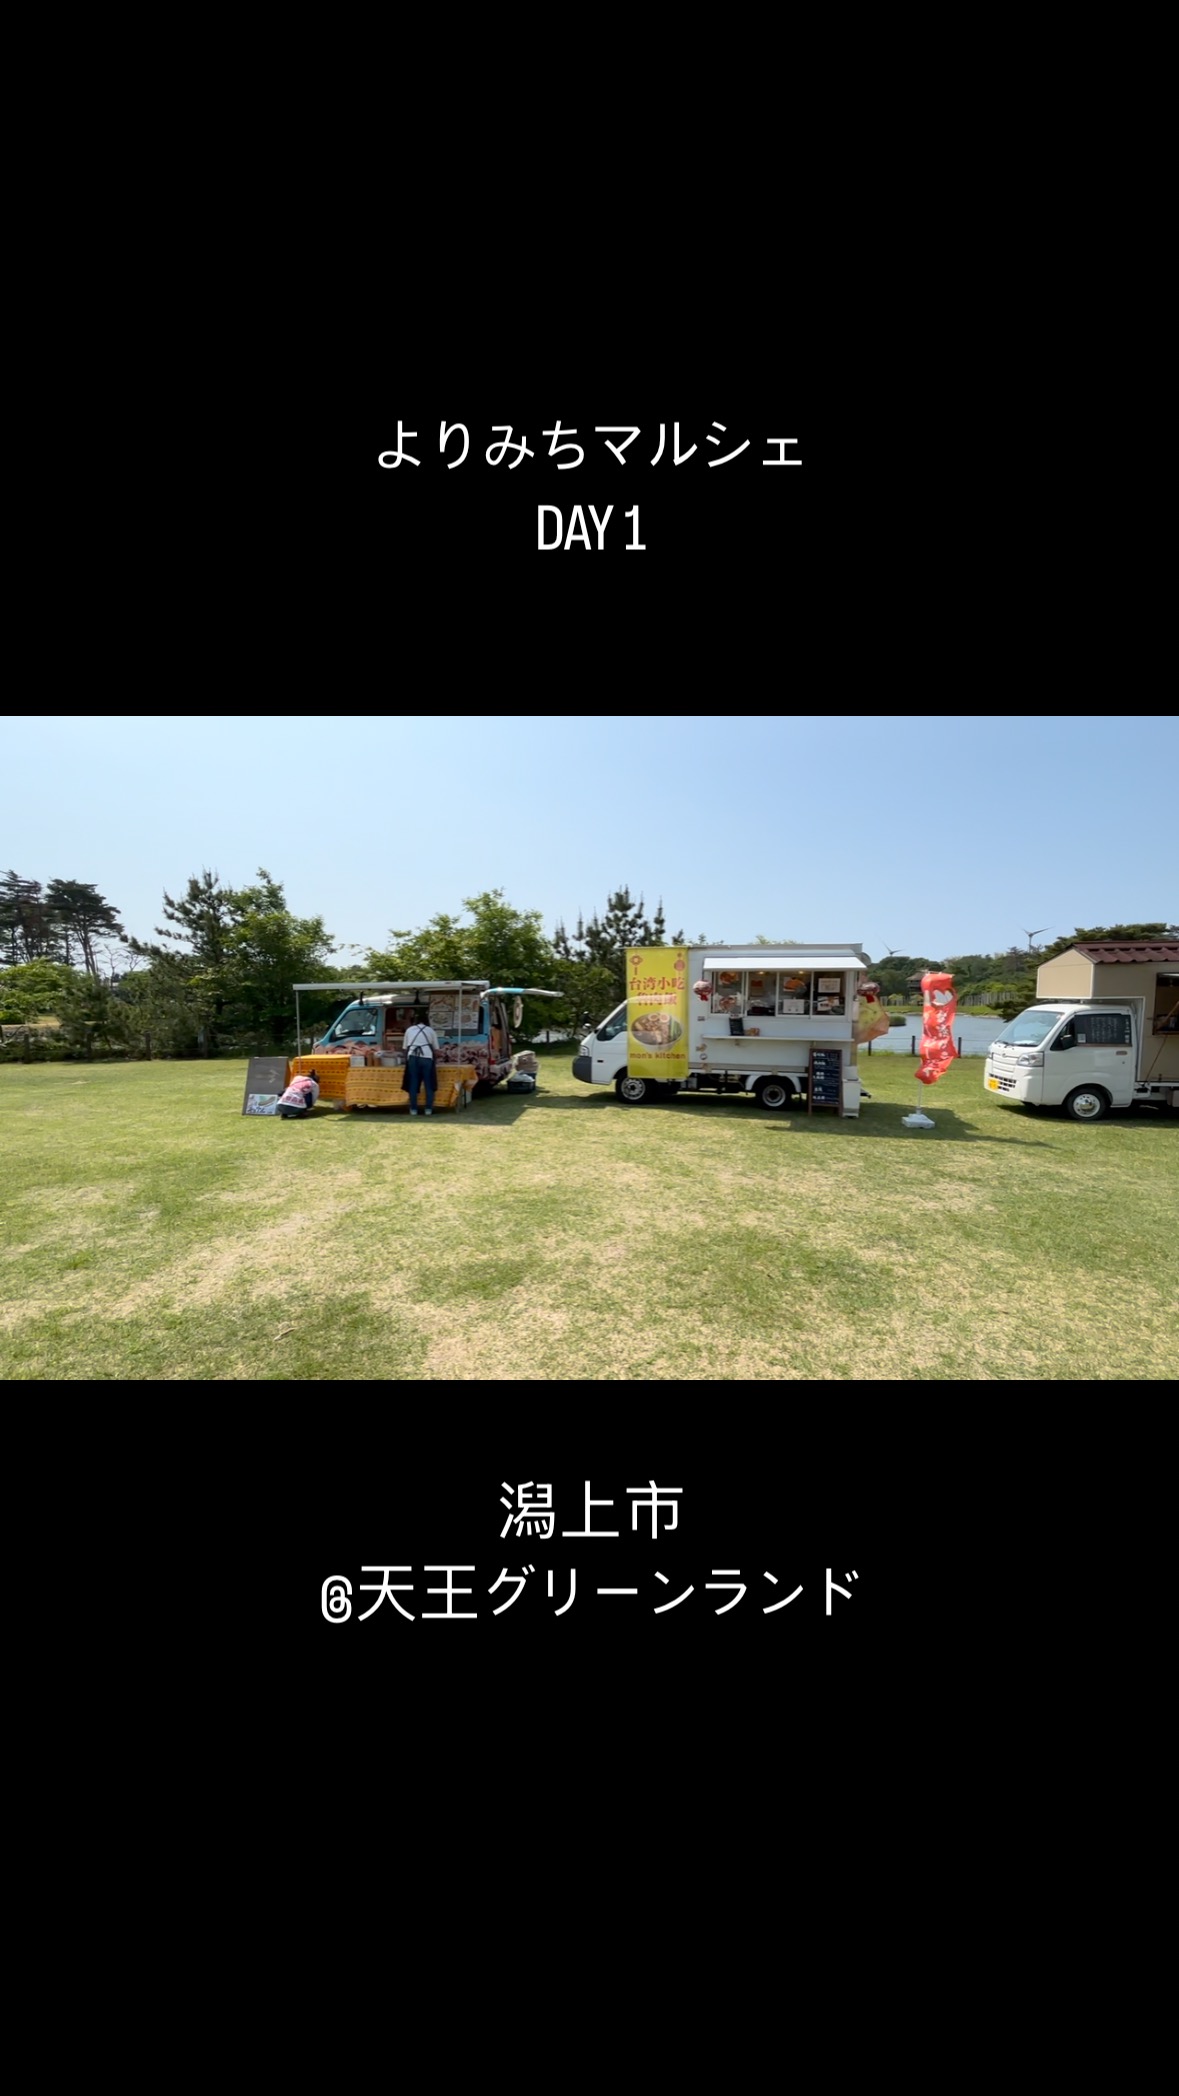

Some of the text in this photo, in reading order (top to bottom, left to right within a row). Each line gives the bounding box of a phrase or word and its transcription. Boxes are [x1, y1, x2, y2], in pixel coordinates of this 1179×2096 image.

[629, 977, 685, 991] 台湾小吃
[655, 1052, 686, 1060] kitchen
